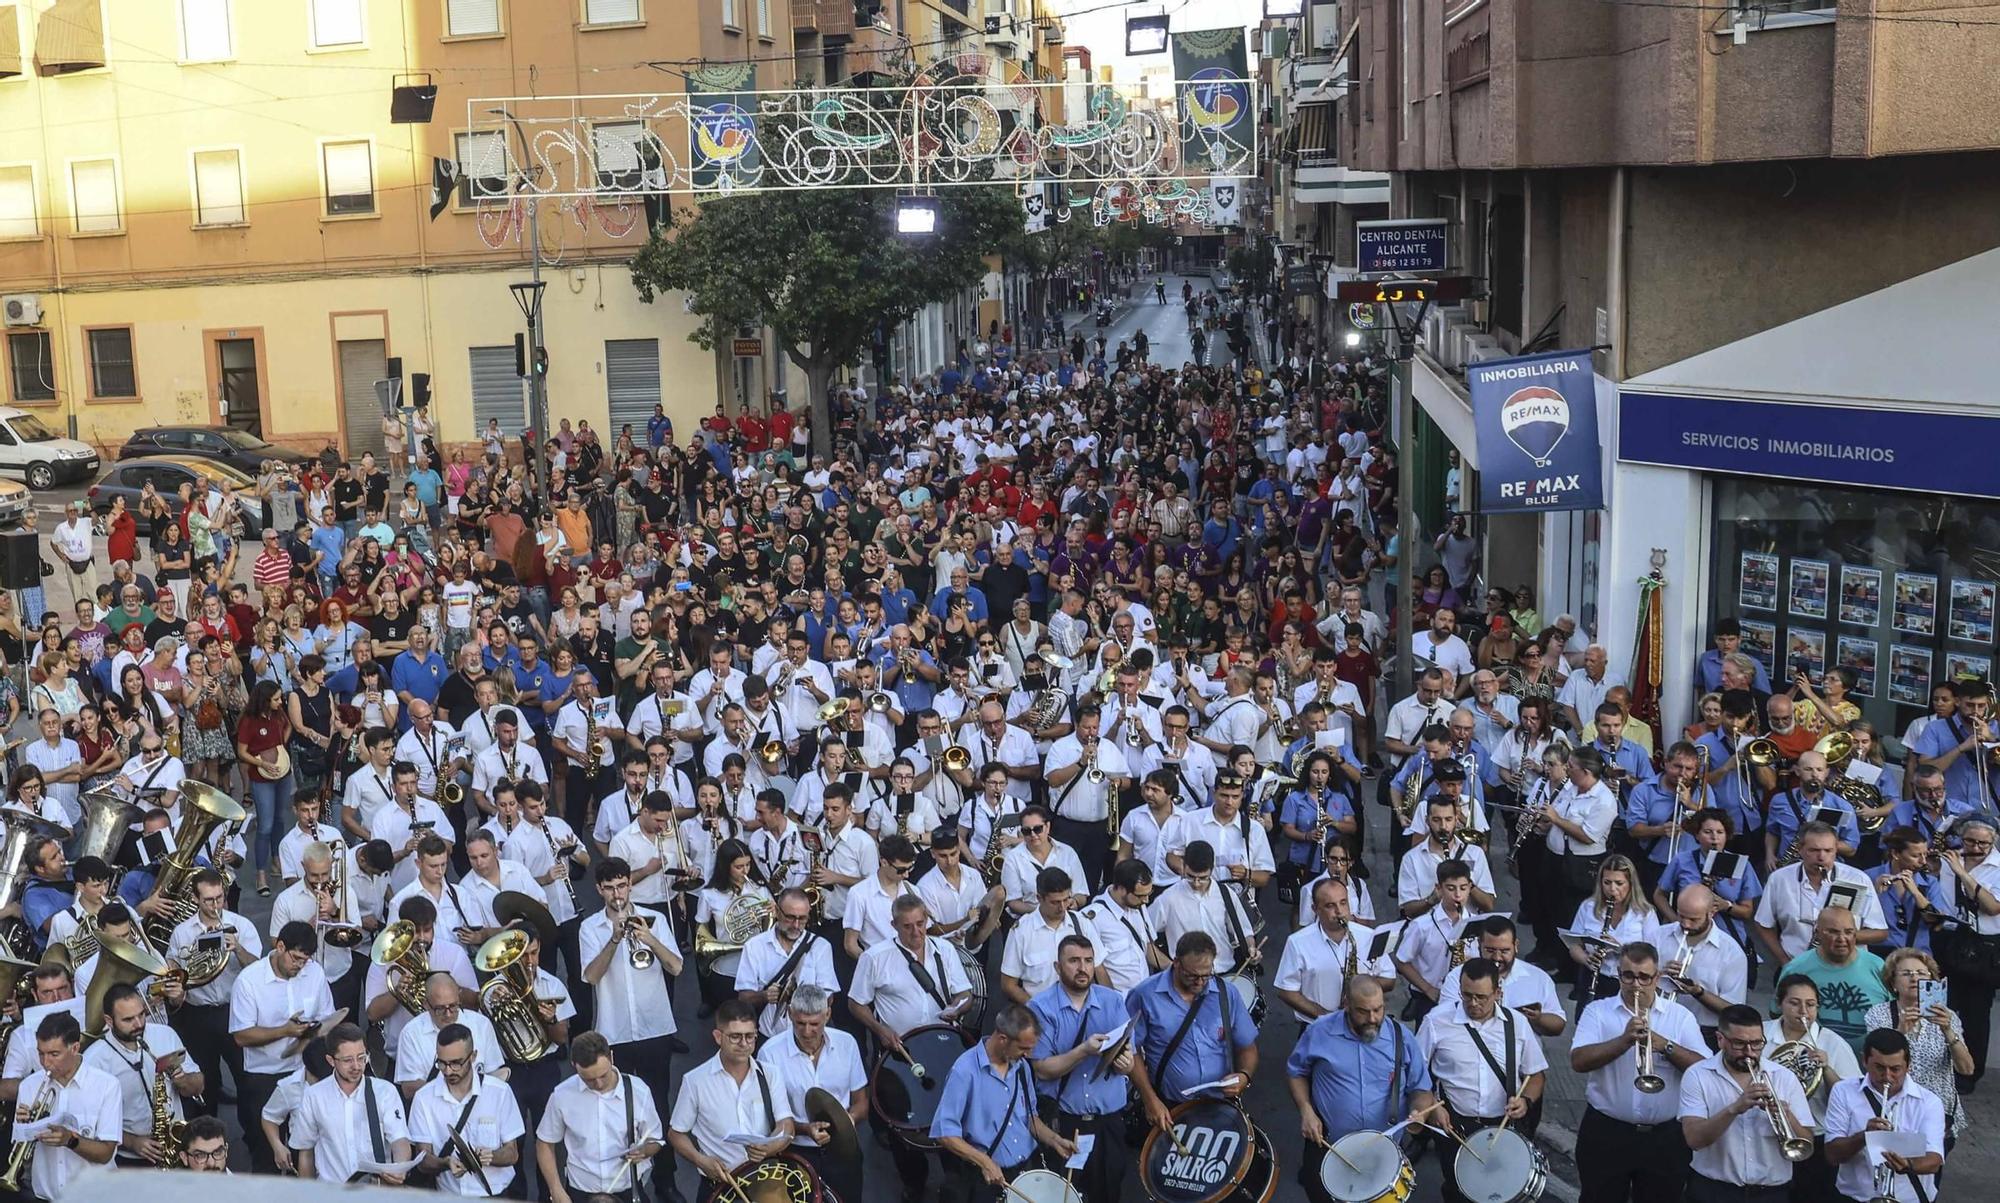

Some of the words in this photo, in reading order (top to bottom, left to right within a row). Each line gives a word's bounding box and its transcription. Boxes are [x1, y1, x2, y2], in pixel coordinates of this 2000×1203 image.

[1360, 231, 1401, 242] CENTRO
[1404, 229, 1445, 240] DENTAL
[1377, 244, 1428, 255] ALICANTE
[1411, 258, 1419, 266] 51
[1480, 360, 1579, 383] INMOBILIARIA
[1510, 405, 1561, 422] RE/MAX
[1681, 431, 1759, 451] SERVICIOS
[1767, 439, 1895, 463] INMOBILIARIOS
[1500, 474, 1581, 498] RE/MAX
[1525, 494, 1559, 506] BLUE
[1169, 1123, 1240, 1166] 100
[757, 1162, 812, 1203] SECT
